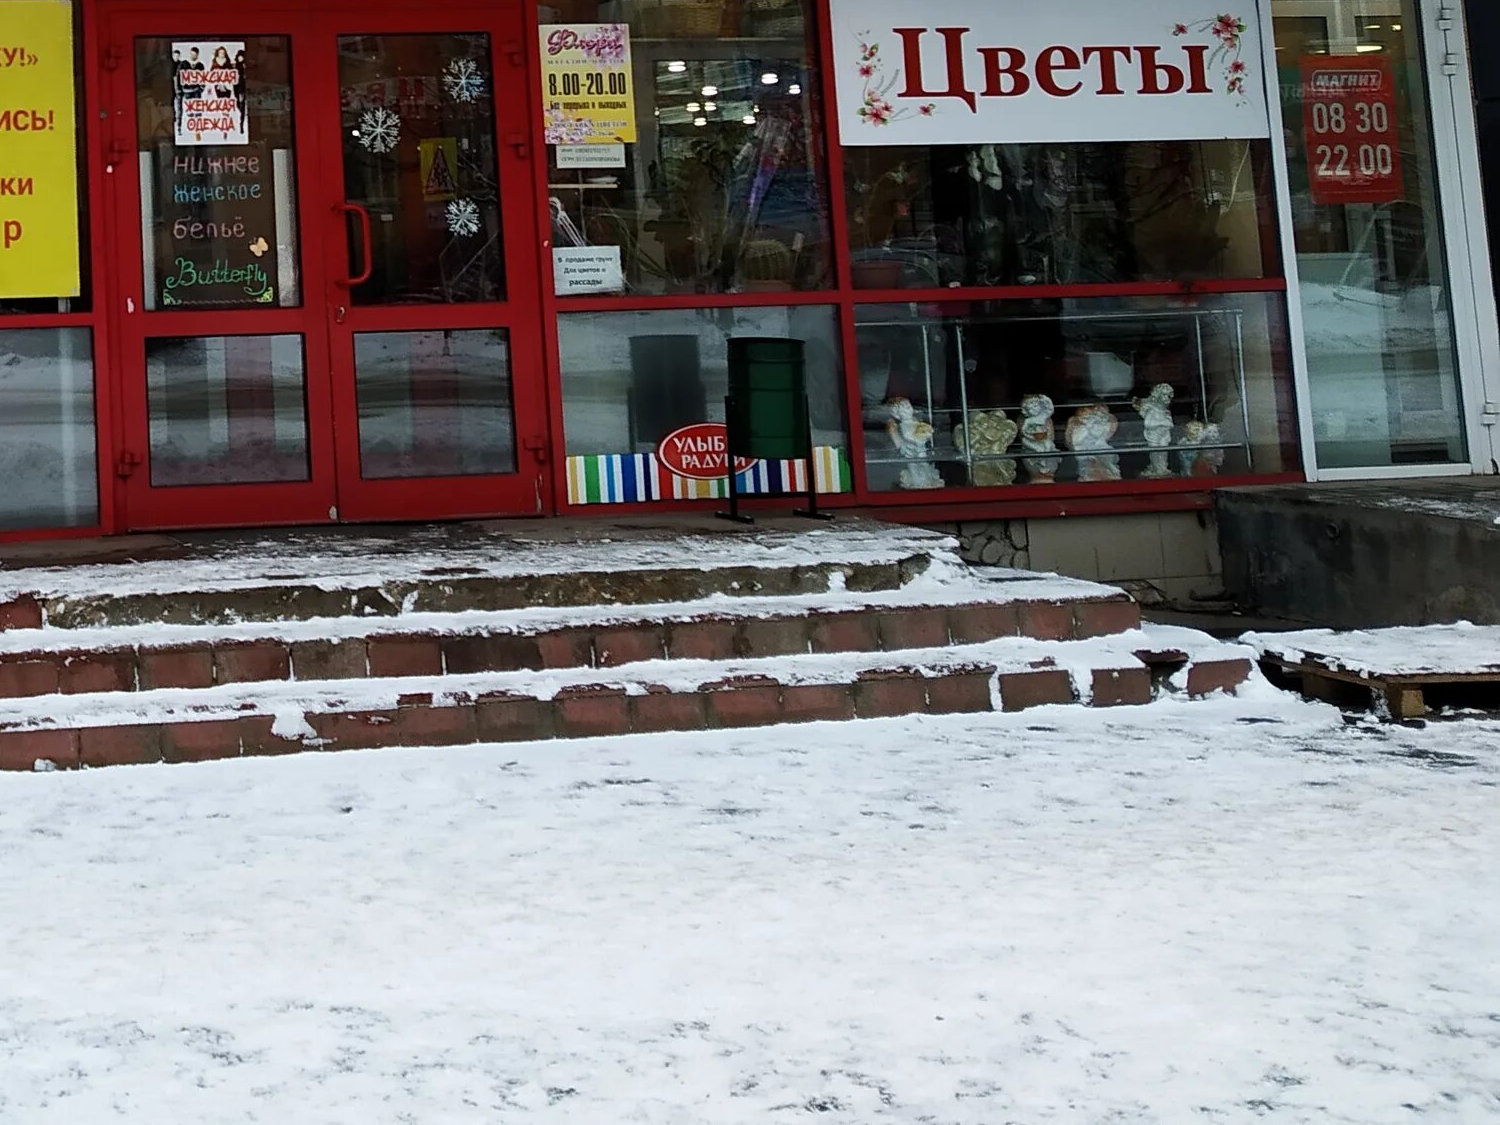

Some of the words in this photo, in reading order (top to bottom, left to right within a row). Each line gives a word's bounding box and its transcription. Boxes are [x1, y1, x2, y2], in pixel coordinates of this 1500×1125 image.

[181, 70, 238, 84] МУЖСКАЯ
[892, 27, 1214, 115] Цветы
[1315, 74, 1379, 87] МАГНИТ
[548, 72, 627, 96] 8.00-20.00
[184, 98, 236, 112] ЖЕНСКАЯ
[187, 117, 236, 132] ОДЕЖДА
[173, 155, 260, 175] нижнее
[174, 183, 261, 204] женское
[3, 219, 23, 249] р
[165, 257, 268, 296] Butterfly
[569, 279, 603, 287] рассады
[673, 435, 726, 453] УЛЫБ
